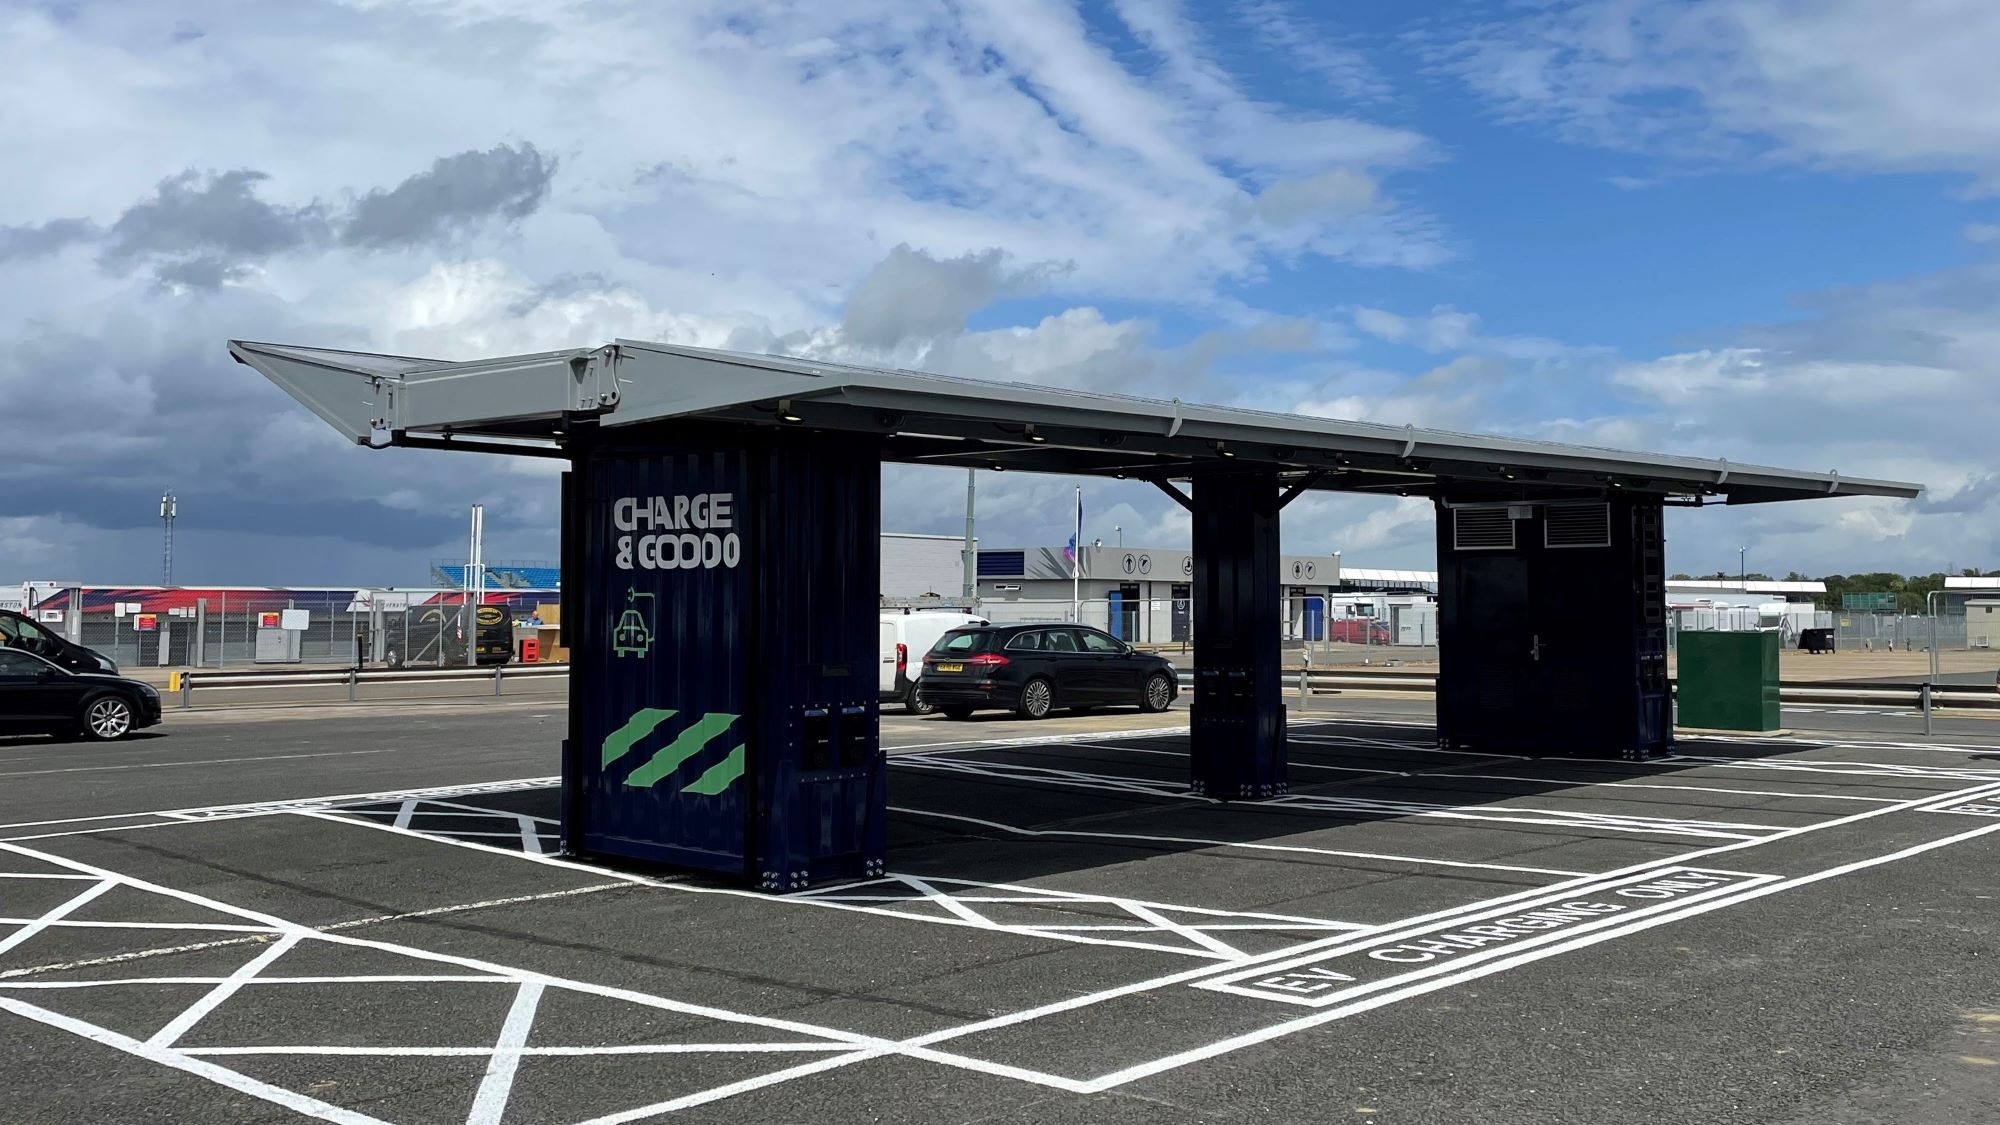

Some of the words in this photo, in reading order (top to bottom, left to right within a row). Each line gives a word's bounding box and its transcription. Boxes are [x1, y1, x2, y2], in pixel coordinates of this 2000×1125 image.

[613, 493, 733, 532] CHARGE
[615, 535, 634, 570] &
[1252, 967, 1357, 993] EV
[1368, 901, 1627, 963] CHARGING
[1615, 872, 1732, 898] ONLY
